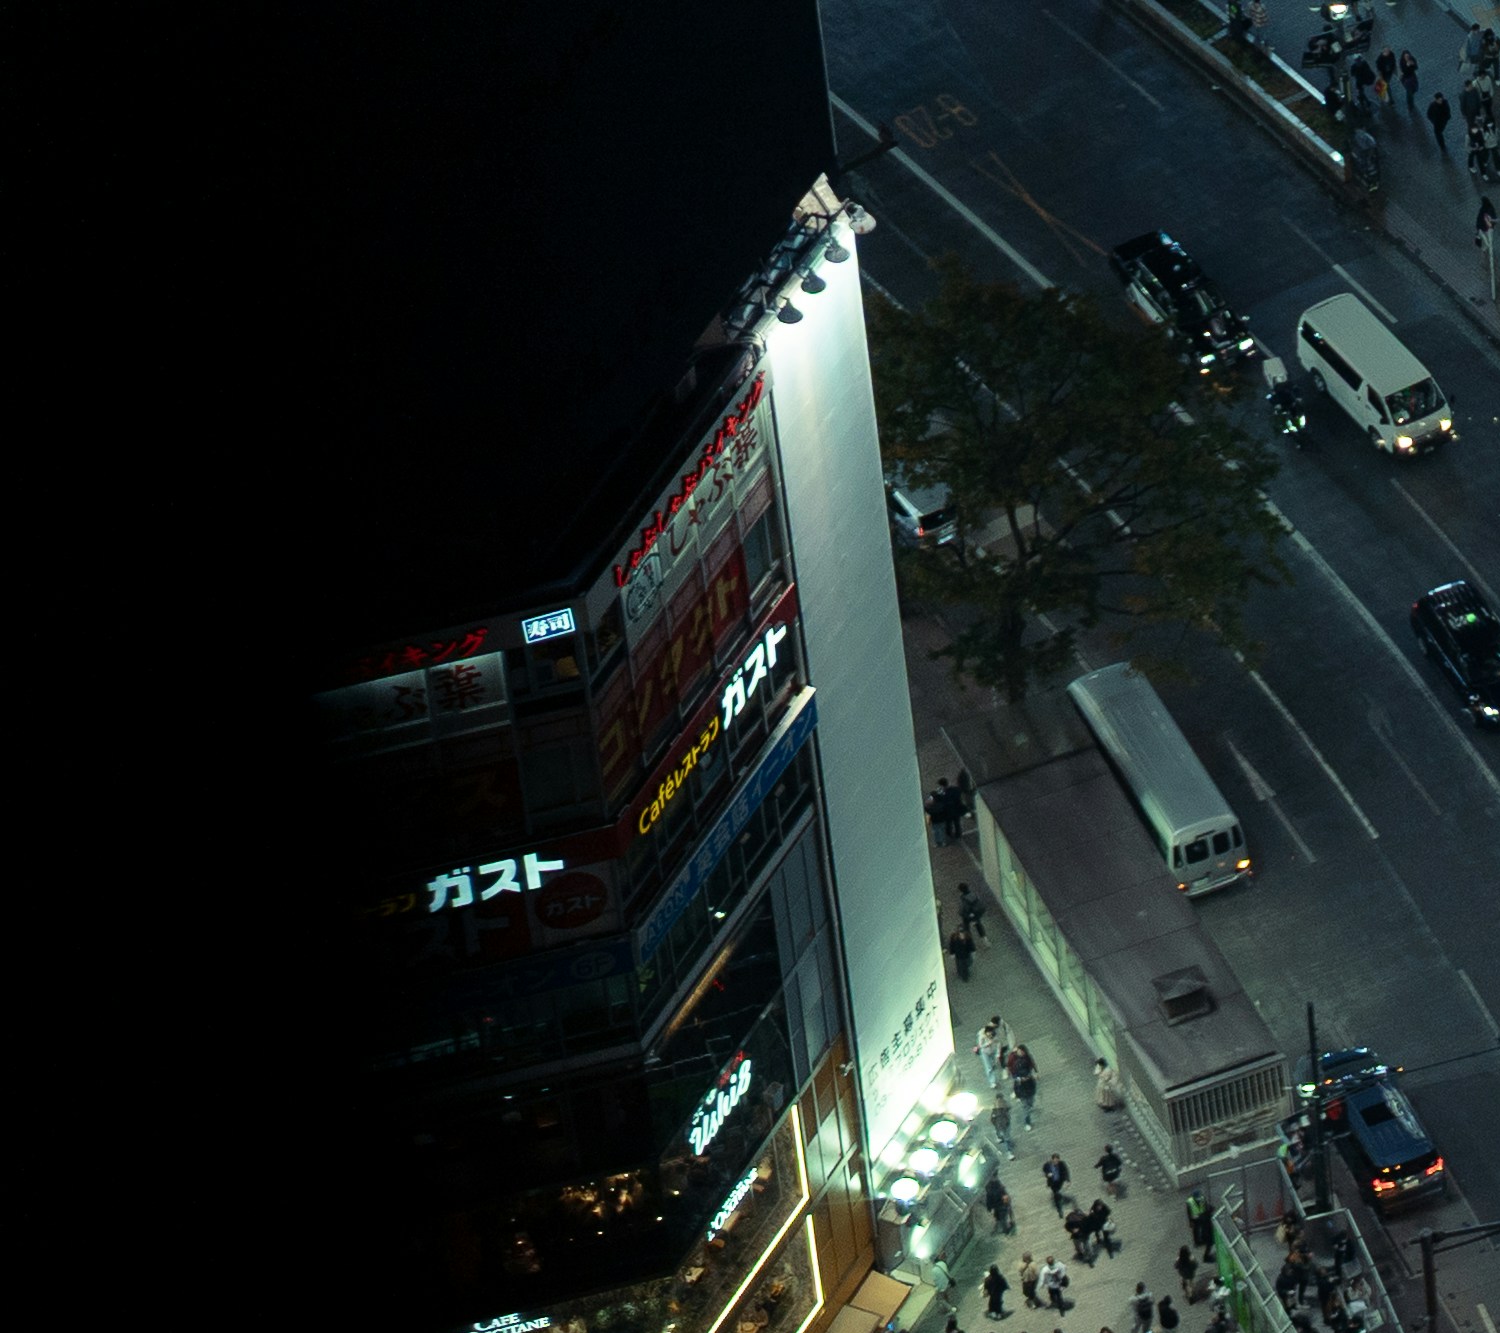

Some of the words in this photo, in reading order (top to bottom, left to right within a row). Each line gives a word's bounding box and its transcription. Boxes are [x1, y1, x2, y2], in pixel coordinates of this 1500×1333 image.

[527, 612, 570, 637] 寿司
[721, 624, 787, 730] ガスト
[427, 852, 565, 913] ガスト
